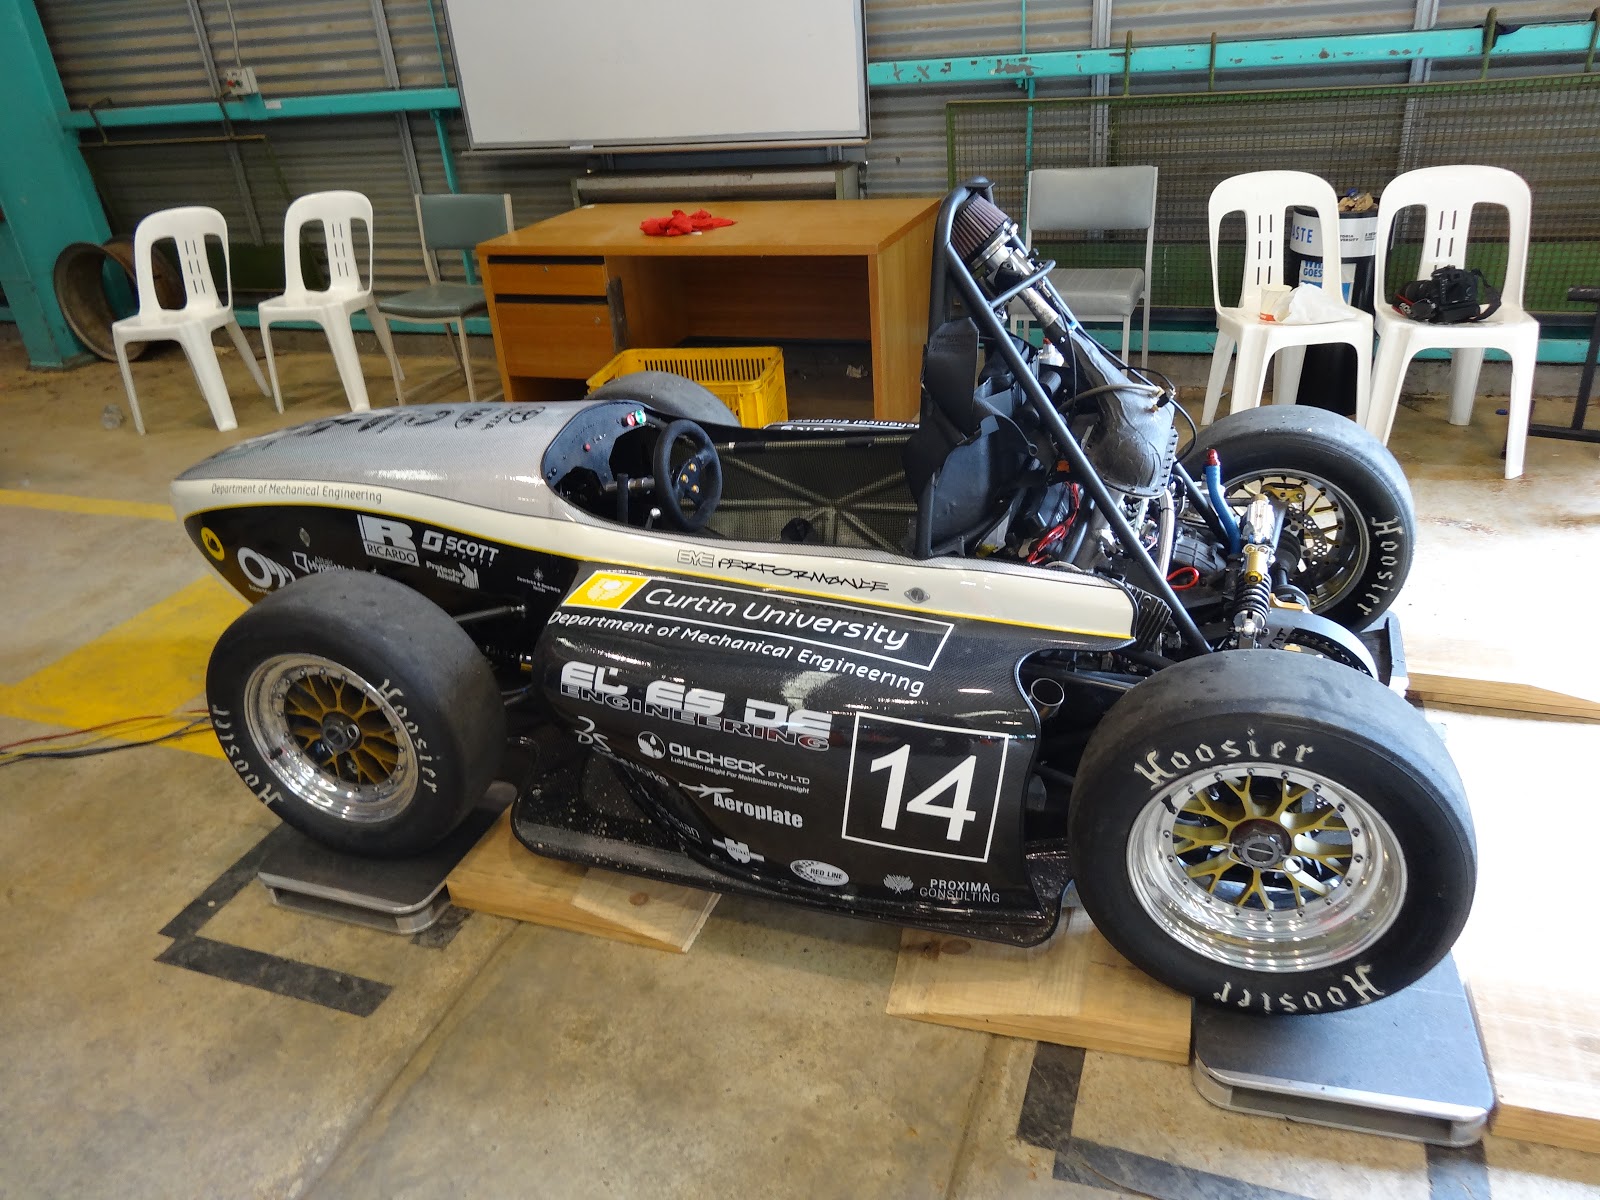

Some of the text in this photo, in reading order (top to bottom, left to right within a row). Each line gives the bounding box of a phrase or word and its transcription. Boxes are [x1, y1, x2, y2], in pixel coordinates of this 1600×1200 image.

[211, 483, 382, 504] Department of Mechanical Engineering
[366, 543, 416, 565] RICARDO
[445, 535, 499, 562] SCOTT
[1357, 515, 1403, 616] Hoosier
[718, 556, 890, 592] PERFORMANCE
[645, 588, 909, 651] Curtin University
[547, 611, 925, 698] Department of Mechanical Engineering
[377, 678, 439, 794] Hoosier
[560, 683, 830, 752] ENGINEERING
[211, 704, 284, 806] Hoosier
[668, 742, 810, 785] OILCHECK PTY LTD
[670, 756, 810, 795] Lubrication Insight For Maintenance Foresight
[1133, 728, 1316, 791] Hoosier
[713, 792, 803, 829] Aeroplate
[869, 743, 977, 842] 14
[810, 867, 825, 877] RED
[827, 870, 843, 881] LINE
[919, 886, 1000, 904] CONSULTING
[929, 878, 991, 893] PROXIMA
[1212, 964, 1386, 1015] Hoosier
